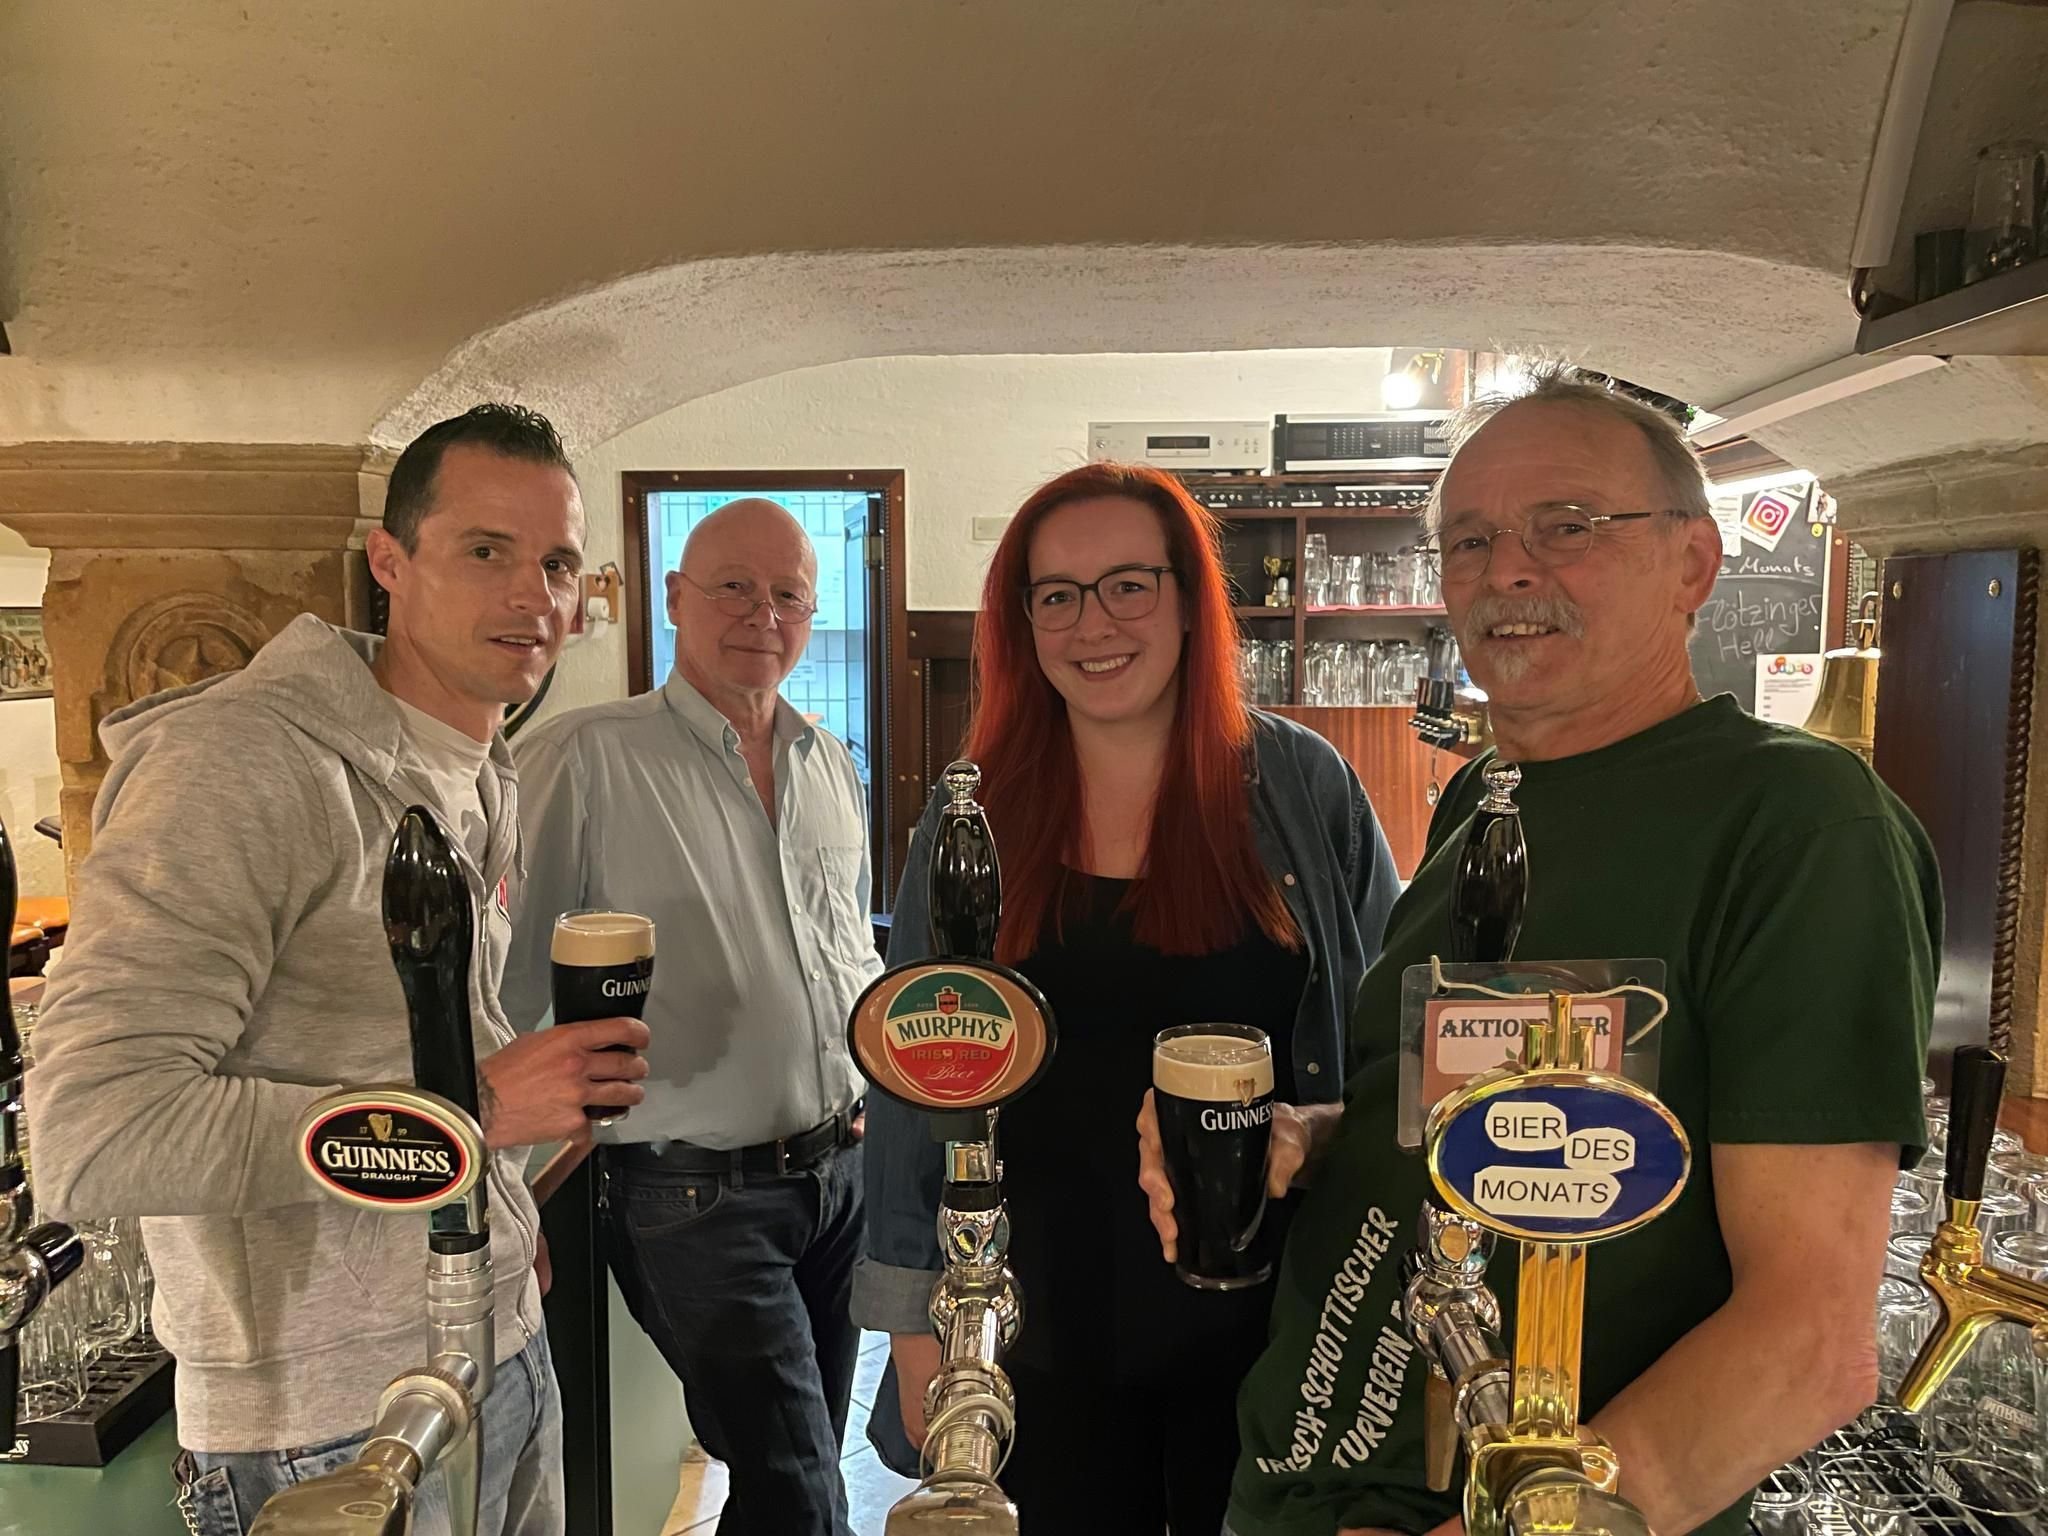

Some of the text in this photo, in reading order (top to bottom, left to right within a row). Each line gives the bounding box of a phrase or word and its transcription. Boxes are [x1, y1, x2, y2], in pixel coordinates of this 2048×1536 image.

[1738, 556, 1816, 577] Monats
[1718, 626, 1777, 663] Hell
[896, 1016, 1003, 1043] MURPHY'S
[959, 1049, 992, 1061] RED
[1492, 1116, 1563, 1139] BIER
[320, 1140, 451, 1173] GUINNESS
[1571, 1138, 1631, 1161] DES
[360, 1171, 419, 1183] DRAUGHT
[1480, 1179, 1609, 1204] MONATS
[1332, 1326, 1415, 1470] TURVEREIN
